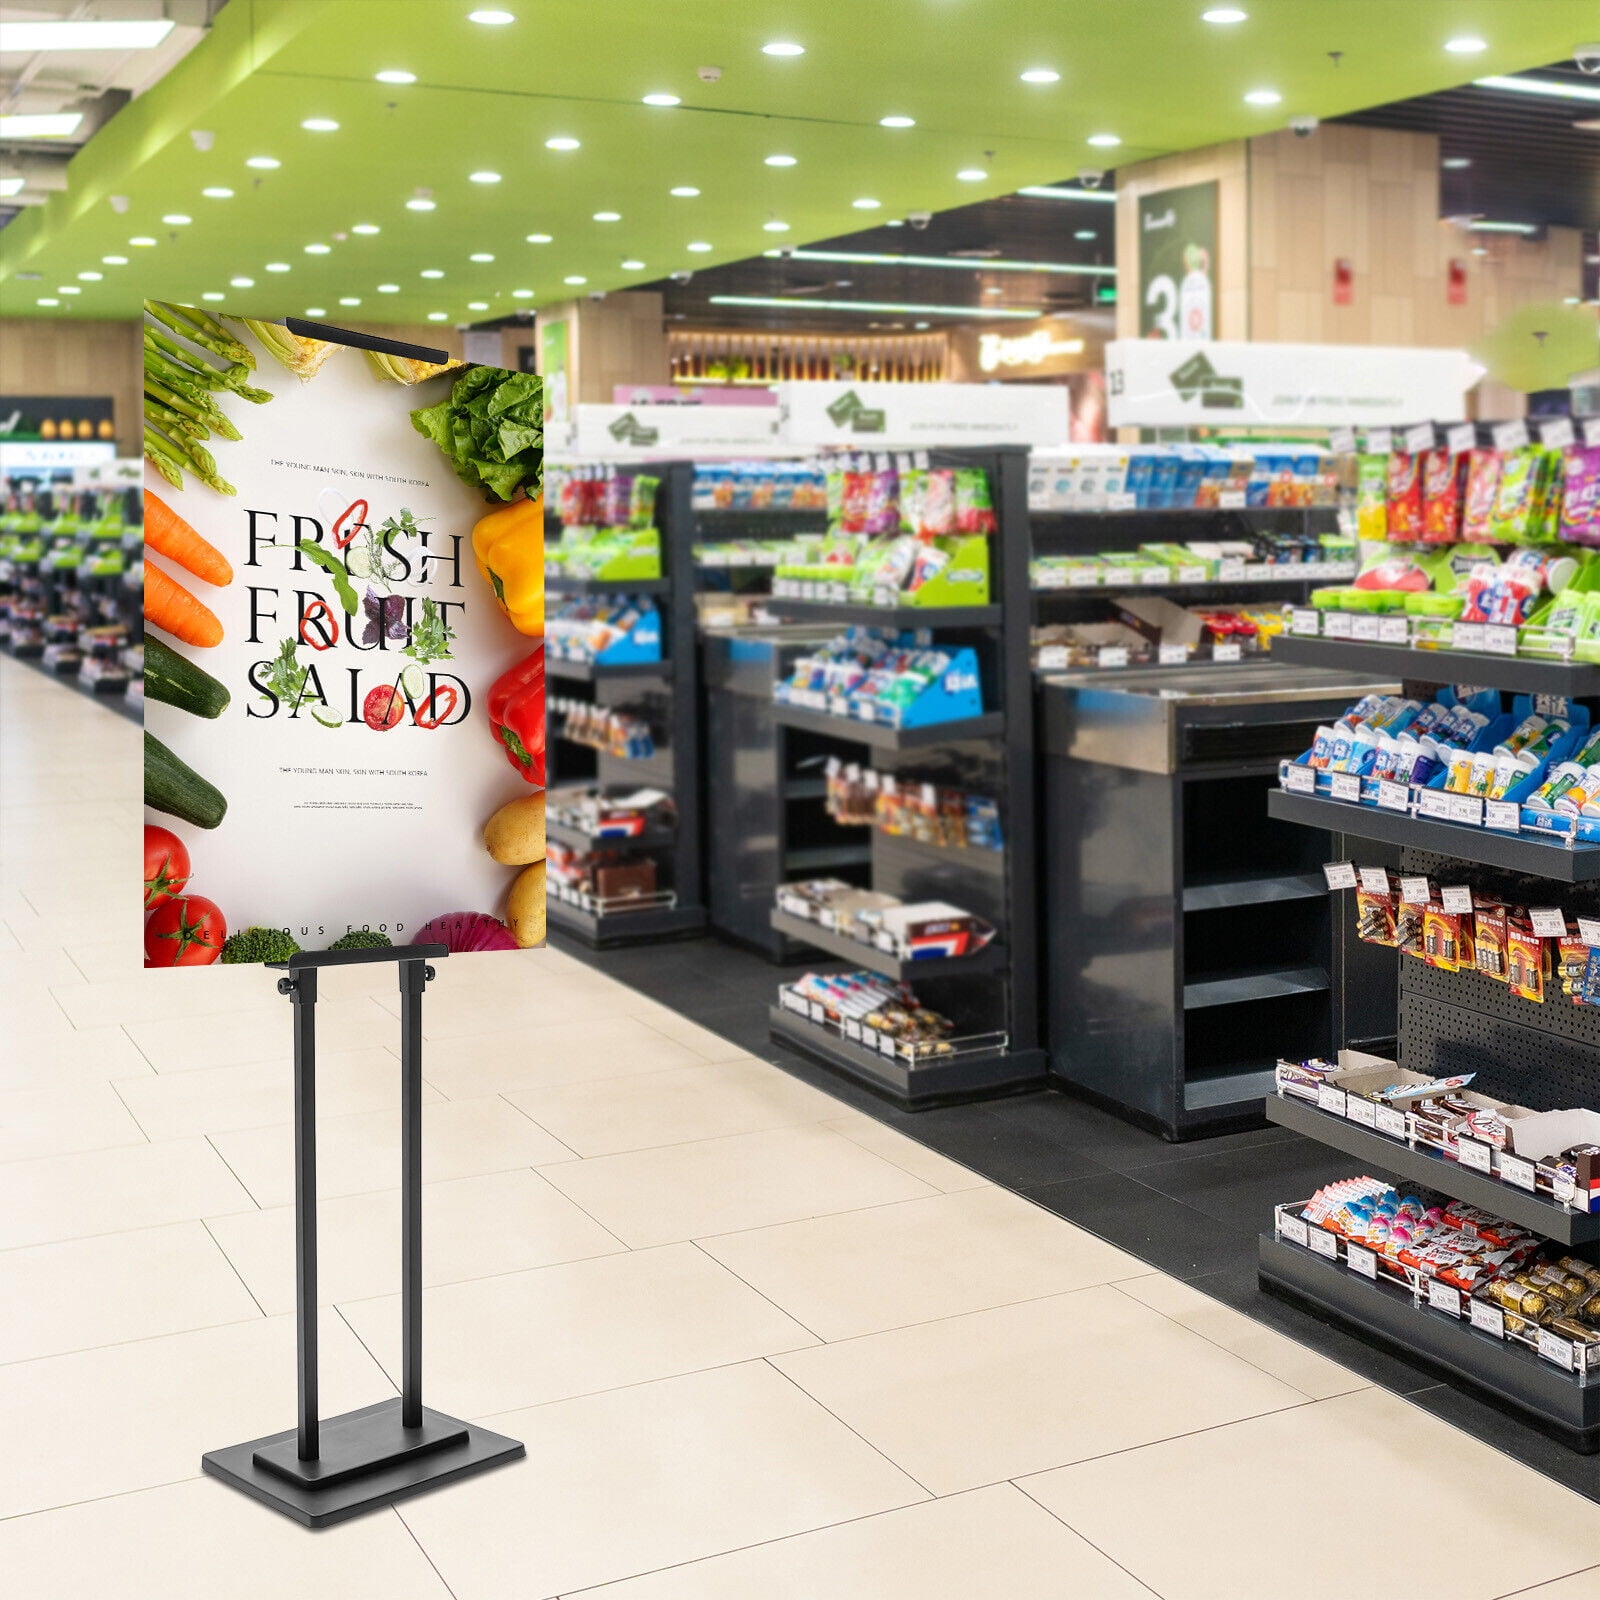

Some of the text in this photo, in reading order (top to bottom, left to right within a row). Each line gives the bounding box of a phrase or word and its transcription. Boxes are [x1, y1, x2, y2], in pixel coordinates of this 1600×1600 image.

[313, 465, 330, 473] MAN
[245, 585, 466, 655] FRUIT
[246, 659, 472, 727] SALAD
[183, 918, 519, 940] DELICIOUS FOOD HEALTHY
